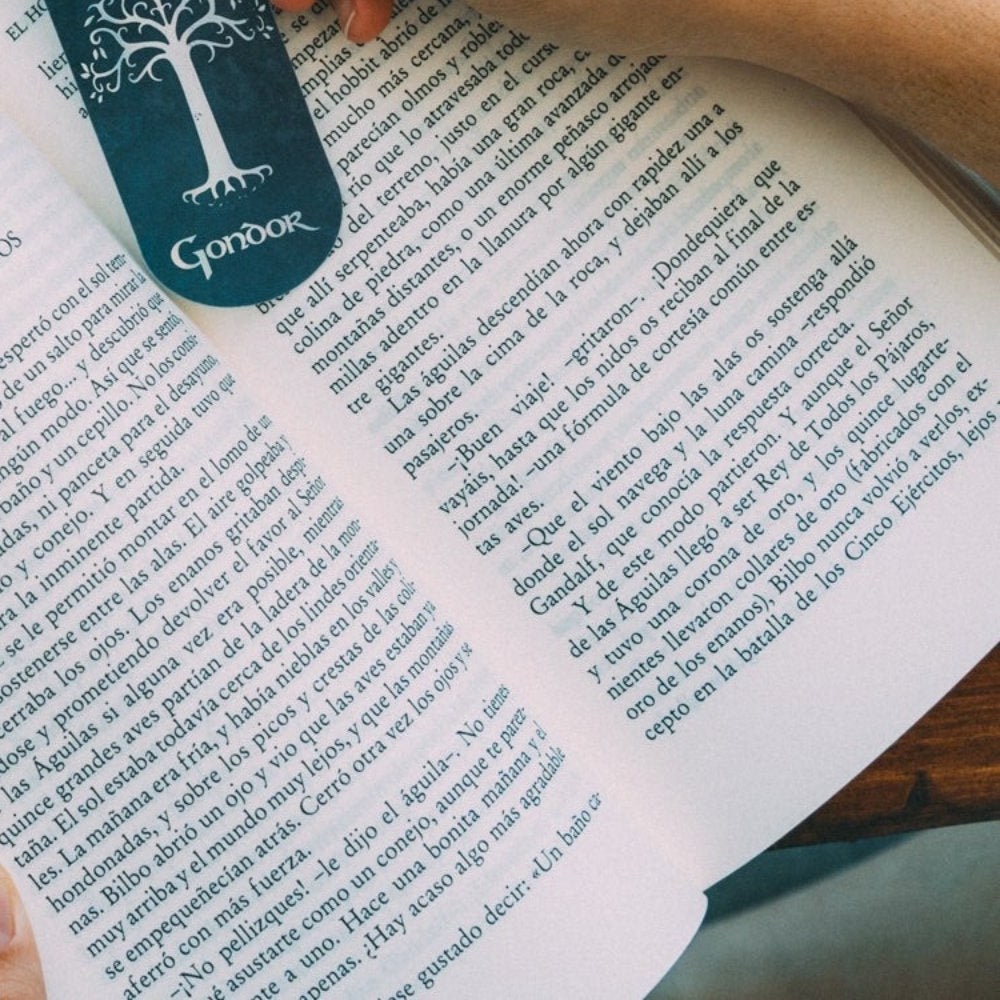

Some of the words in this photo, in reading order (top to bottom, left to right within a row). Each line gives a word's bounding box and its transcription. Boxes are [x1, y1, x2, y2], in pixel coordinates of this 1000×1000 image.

[5, 21, 29, 42] EL
[312, 97, 332, 120] el
[330, 57, 381, 106] hobbit
[380, 20, 419, 61] abrió
[416, 5, 439, 25] de
[323, 98, 376, 148] mucho
[377, 67, 409, 99] más
[410, 17, 471, 68] cercana,
[336, 112, 401, 177] parecían
[401, 69, 447, 112] olmos
[445, 56, 460, 76] y
[347, 173, 373, 198] río
[374, 144, 404, 175] que
[399, 127, 423, 146] lo
[423, 59, 498, 129] atravesaba
[51, 295, 80, 321] con
[78, 278, 93, 299] el
[90, 263, 111, 288] sol
[105, 254, 127, 274] tem-
[275, 306, 305, 336] que
[306, 276, 335, 308] allí
[335, 199, 431, 282] serpenteaba,
[425, 156, 473, 196] había
[471, 128, 503, 156] una
[502, 96, 538, 133] gran
[536, 65, 577, 98] roca,
[329, 351, 377, 395] millas
[379, 296, 439, 353] adentro
[442, 274, 464, 295] en
[460, 257, 483, 275] la
[479, 206, 538, 257] llanura
[537, 177, 566, 211] por
[567, 139, 609, 179] algún
[608, 89, 661, 144] gigante
[660, 66, 684, 91] en-
[386, 385, 421, 414] Las
[420, 335, 477, 388] águilas
[477, 259, 561, 336] descendían
[560, 218, 605, 260] ahora
[603, 191, 633, 219] con
[631, 140, 686, 192] rapidez
[683, 114, 714, 142] una
[712, 103, 726, 117] a
[510, 372, 555, 415] viaje!
[753, 160, 782, 190] que
[14, 377, 77, 426] fuego...
[76, 359, 89, 379] y
[89, 303, 149, 362] descubrió
[147, 292, 165, 313] que
[37, 500, 58, 520] ni
[58, 445, 121, 507] panceta
[120, 414, 156, 452] para
[154, 394, 171, 416] el
[167, 355, 218, 403] desayuno,
[346, 392, 372, 415] tre
[375, 332, 444, 396] gigantes.
[453, 474, 524, 540] jornada!
[562, 383, 630, 443] fórmula
[628, 361, 651, 383] de
[652, 307, 710, 362] cortesía
[709, 258, 760, 307] común
[759, 220, 797, 259] entre
[796, 200, 817, 222] es-
[571, 490, 589, 513] el
[591, 446, 643, 492] viento
[641, 409, 681, 444] bajo
[680, 383, 709, 408] las
[712, 350, 743, 382] alas
[745, 329, 765, 349] os
[767, 268, 828, 328] sostenga
[829, 234, 859, 267] allá
[14, 591, 39, 609] la
[39, 517, 123, 592] inminente
[125, 466, 185, 524] partida.
[529, 556, 605, 616] Gandalf,
[606, 525, 638, 557] que
[640, 467, 703, 525] conocía
[699, 448, 723, 467] la
[723, 380, 792, 448] respuesta
[793, 322, 855, 379] correcta.
[606, 650, 665, 701] nientes
[661, 592, 734, 652] llevaron
[735, 532, 795, 591] collares
[795, 511, 818, 533] de
[819, 483, 847, 511] oro
[845, 402, 926, 483] (fabricados
[927, 374, 957, 403] con
[955, 351, 973, 374] el
[0, 778, 31, 804] las
[34, 723, 99, 781] Águilas
[102, 707, 120, 724] si
[123, 657, 181, 708] alguna
[182, 626, 214, 654] vez
[217, 600, 244, 626] era
[246, 546, 305, 605] posible,
[303, 499, 344, 544] mientras
[53, 661, 86, 688] los
[88, 628, 130, 662] ojos.
[127, 593, 165, 625] Los
[168, 541, 224, 594] enanos
[225, 486, 282, 546] gritaban
[278, 457, 307, 487] despi-
[123, 951, 176, 1000] aferró
[178, 926, 213, 956] con
[213, 895, 250, 929] más
[249, 849, 312, 898] fuerza.
[218, 879, 310, 967] pellizques!
[343, 825, 378, 858] dijo
[382, 800, 400, 825] el
[456, 719, 484, 747] No
[482, 687, 510, 719] tienes
[417, 925, 483, 990] gustado
[483, 880, 531, 926] decir:
[556, 810, 591, 847] baño
[588, 792, 602, 811] ca-
